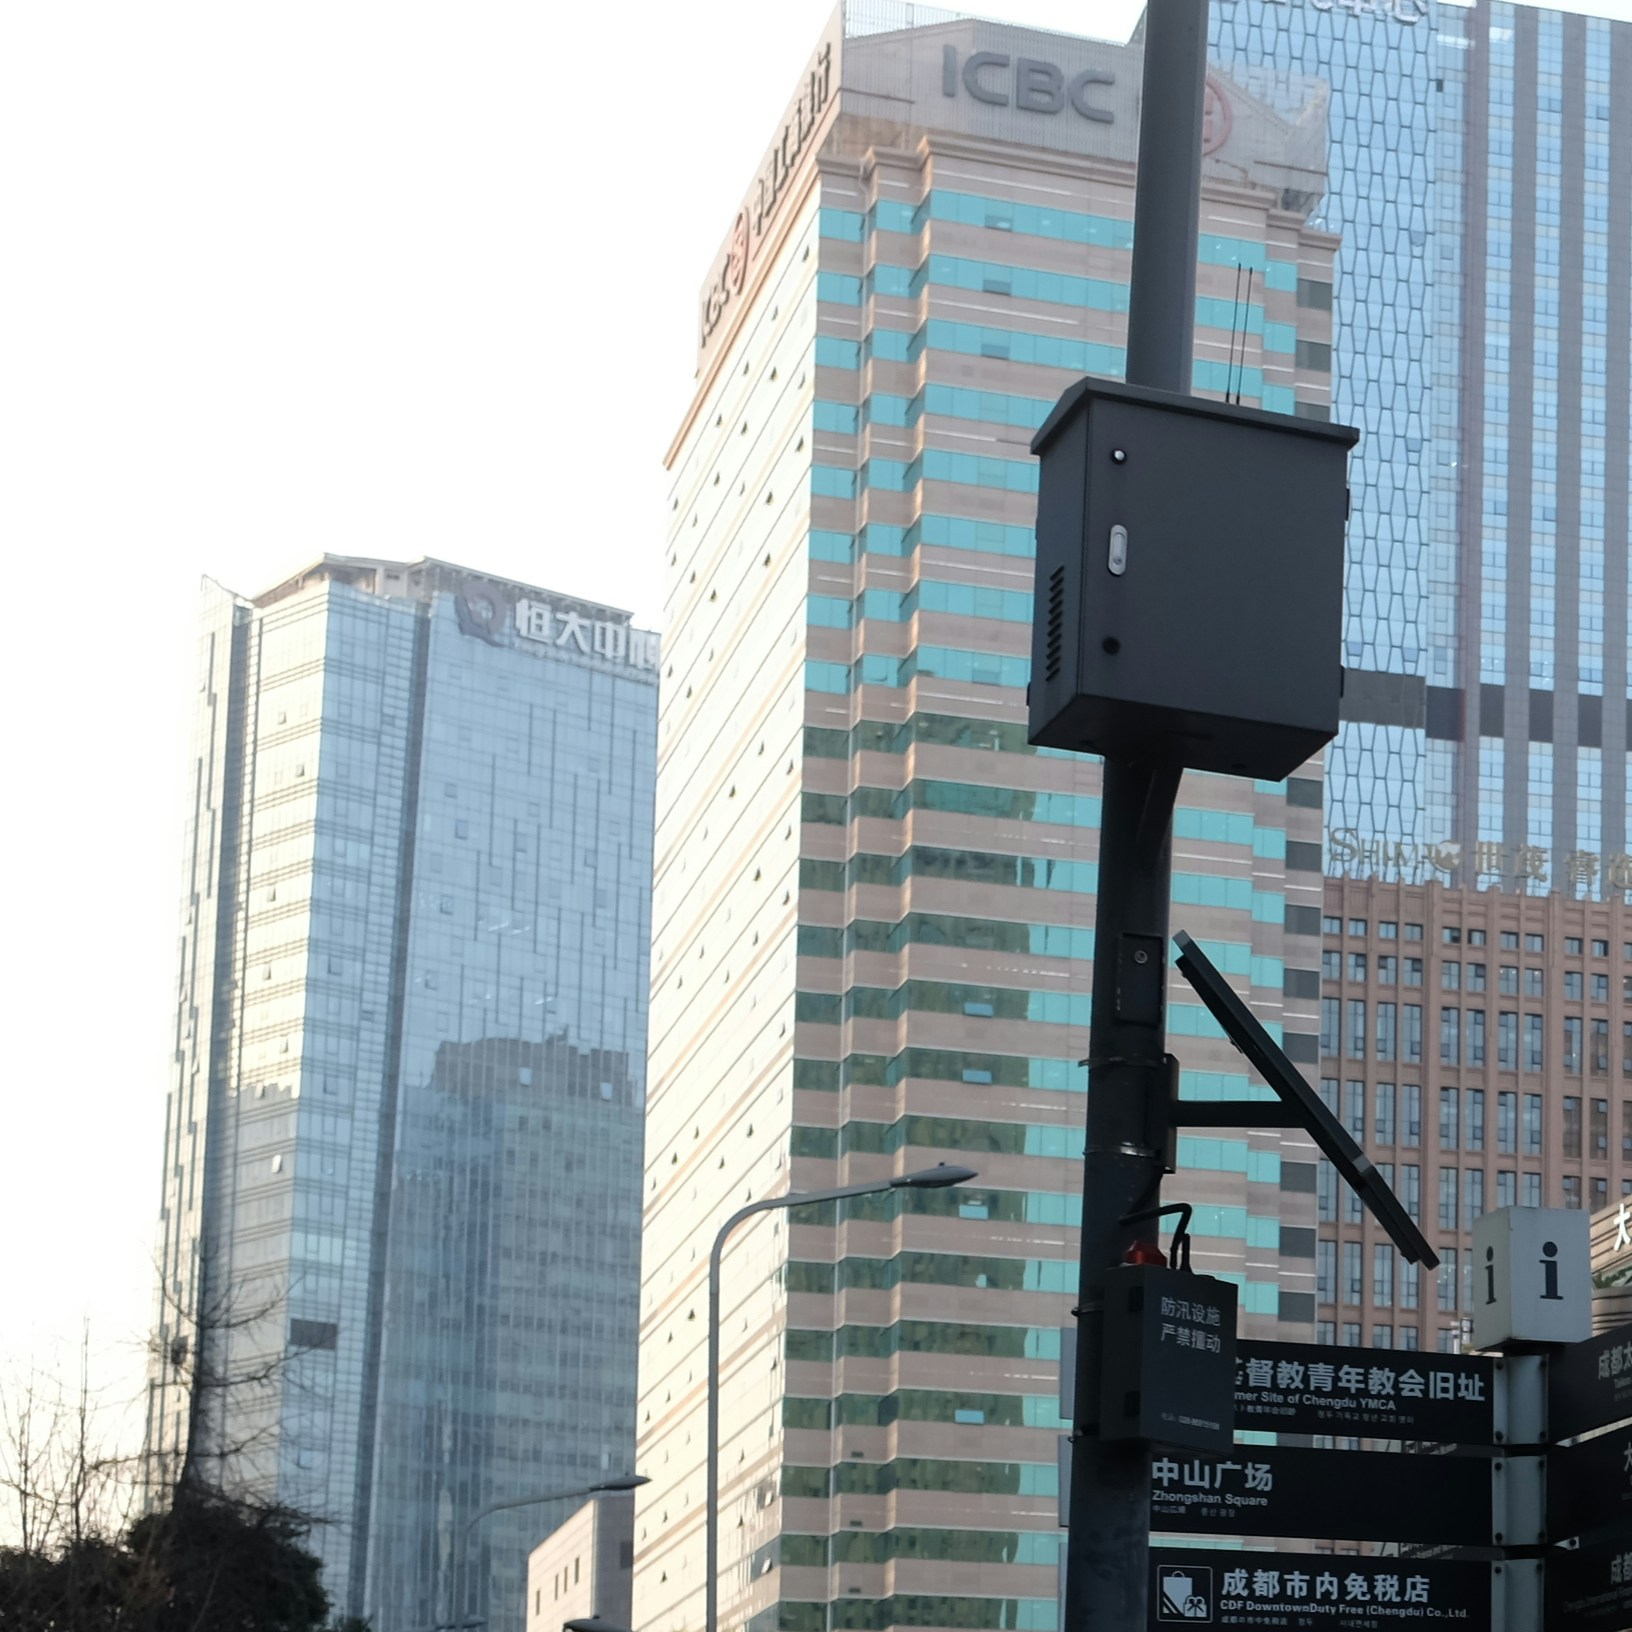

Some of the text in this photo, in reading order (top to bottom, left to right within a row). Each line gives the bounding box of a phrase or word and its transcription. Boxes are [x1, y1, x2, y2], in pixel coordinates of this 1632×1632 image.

[942, 44, 1115, 125] ICBC
[1161, 1296, 1220, 1326] 防汛设施
[1260, 1391, 1284, 1404] Site
[1286, 1393, 1300, 1405] of
[1302, 1394, 1357, 1411] Chengdu
[1360, 1399, 1397, 1411] YMCA
[1152, 1457, 1273, 1492] 中山广场
[1152, 1489, 1268, 1507] Zhongshan Square
[1220, 1568, 1431, 1605] 成都市内免税店
[1219, 1599, 1244, 1611] CDF
[1339, 1604, 1364, 1616] Free
[1365, 1604, 1425, 1618] (Chengdu)
